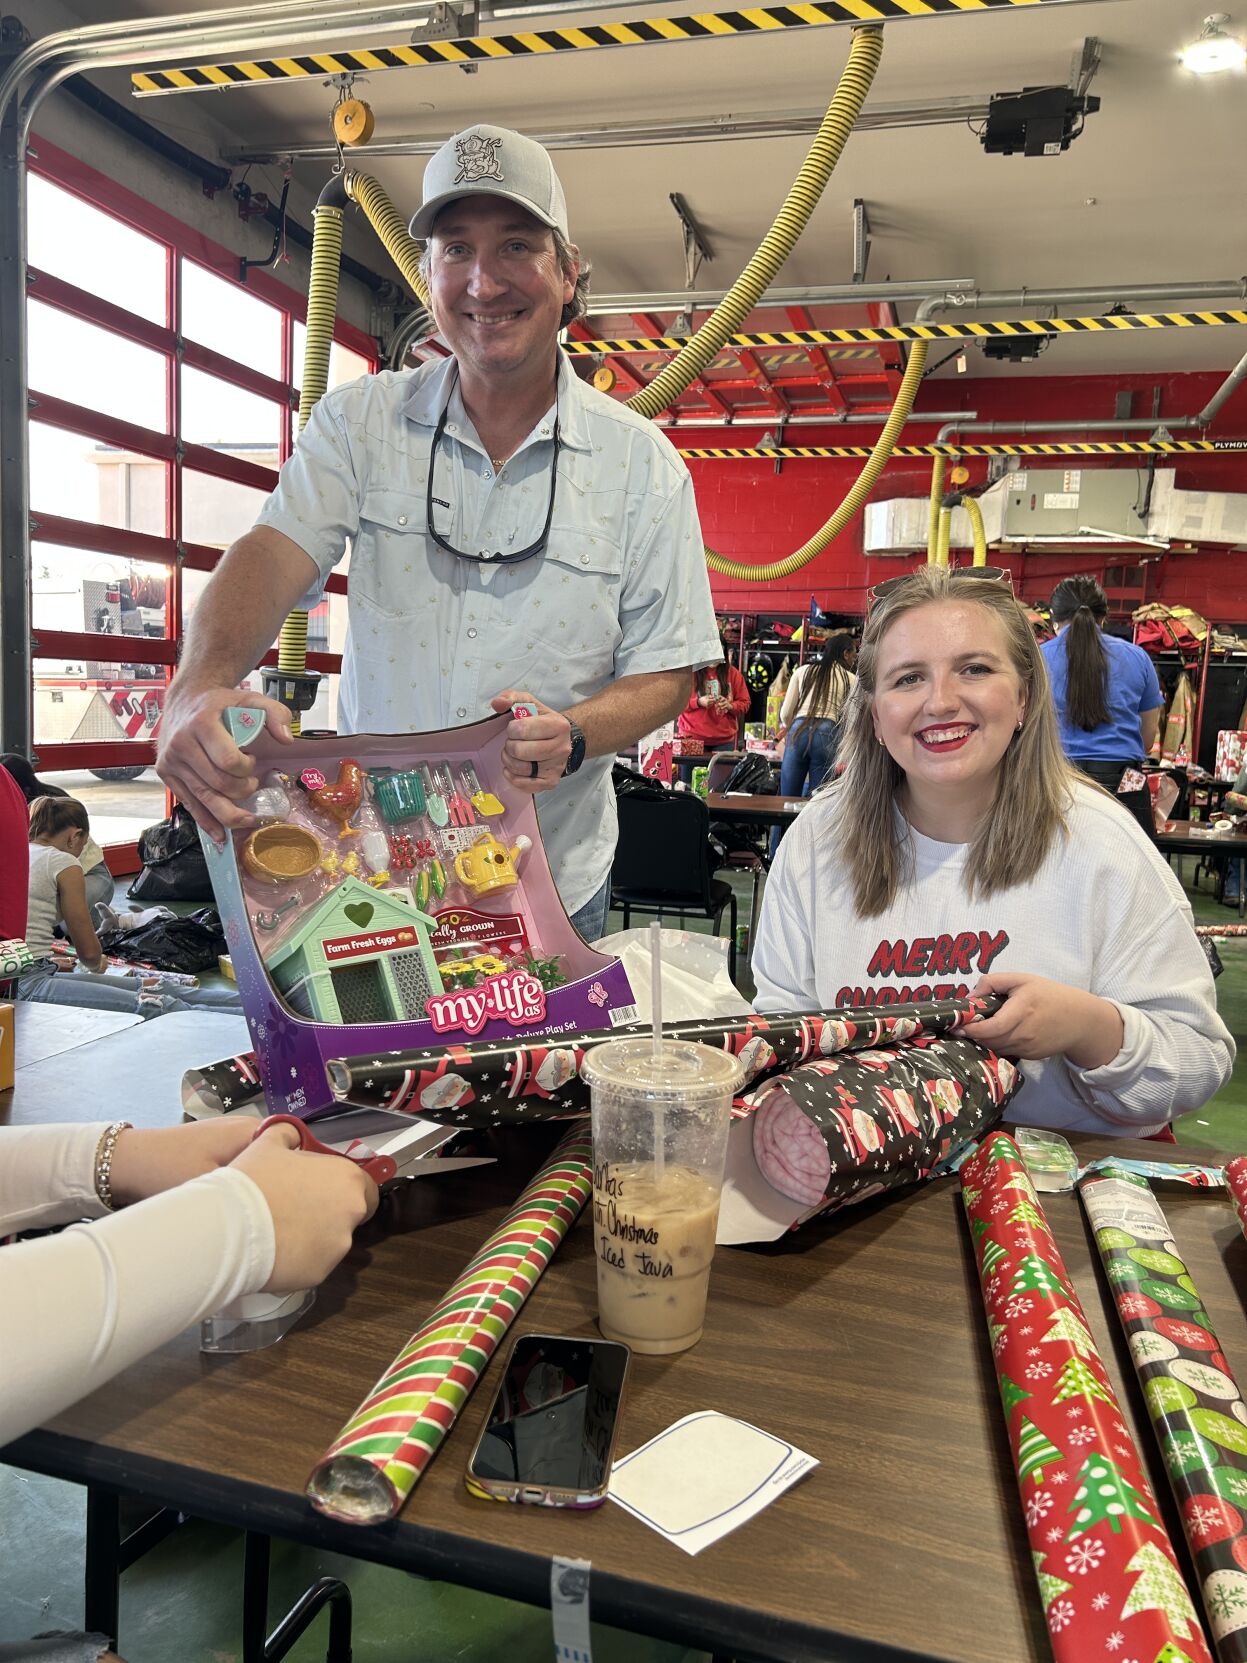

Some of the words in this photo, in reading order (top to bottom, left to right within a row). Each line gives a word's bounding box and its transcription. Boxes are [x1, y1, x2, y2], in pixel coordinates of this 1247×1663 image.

[460, 922, 495, 933] GROWN
[327, 944, 351, 954] Farm
[351, 938, 376, 950] Fresh
[375, 936, 397, 947] Eggs
[867, 930, 1010, 978] MERRY
[432, 994, 486, 1028] my
[491, 973, 541, 1019] life
[524, 1004, 541, 1018] as
[544, 1025, 564, 1035] Play
[564, 1020, 578, 1031] Set
[607, 1200, 659, 1245] Christmas
[601, 1236, 625, 1269] Iced
[634, 1252, 673, 1279] Java
